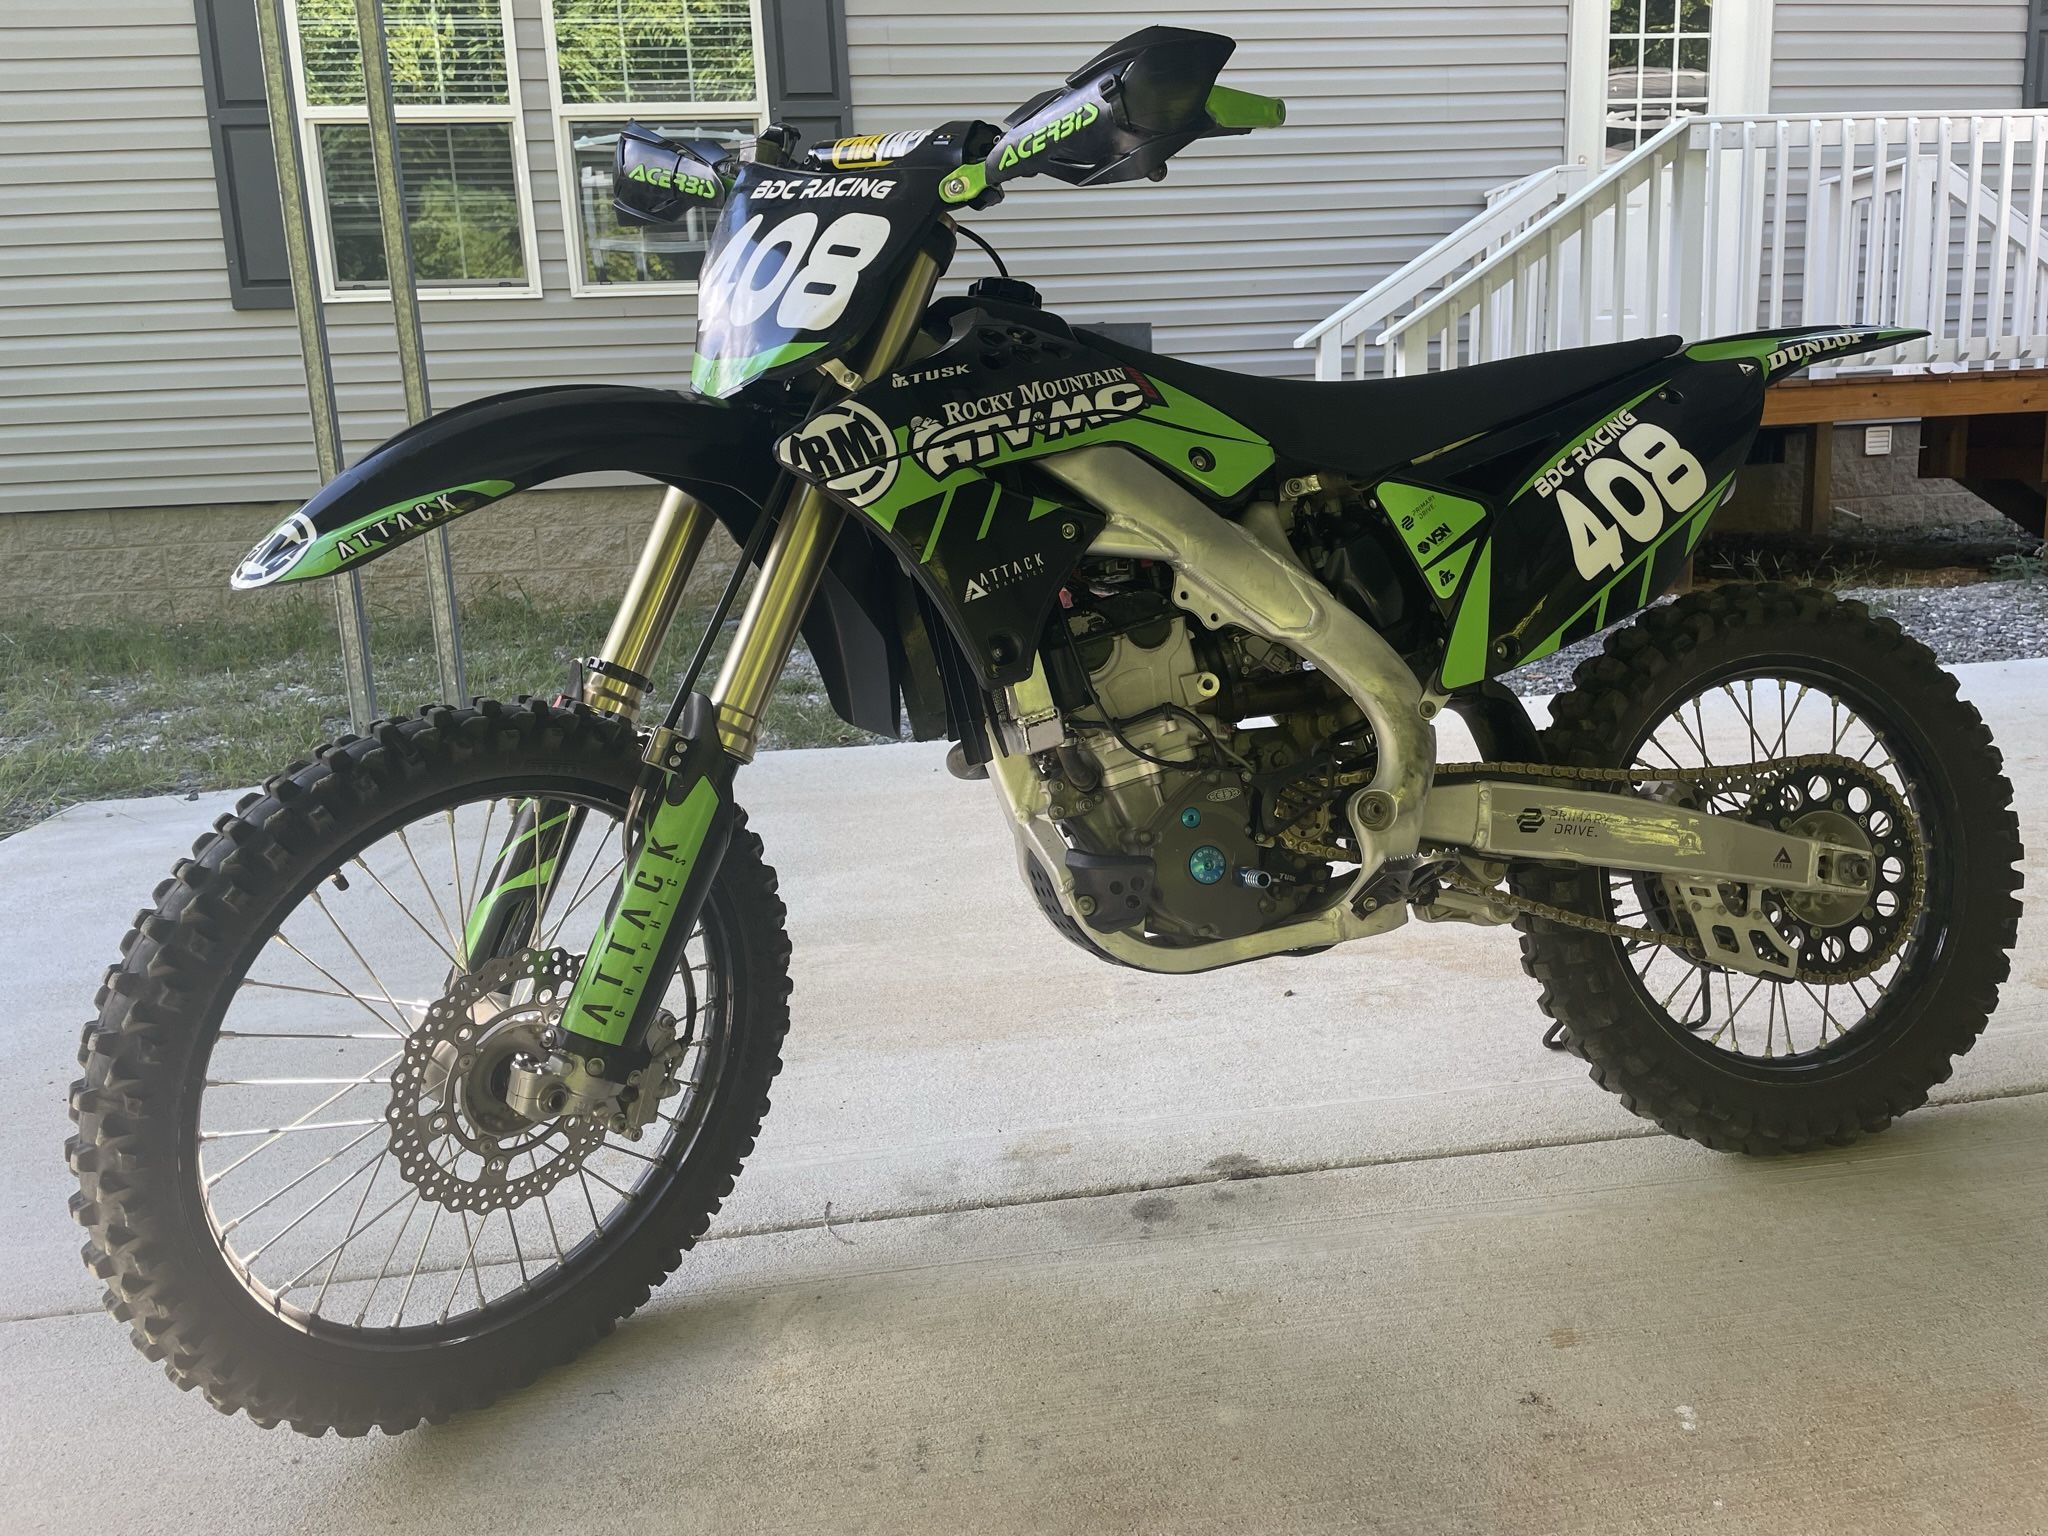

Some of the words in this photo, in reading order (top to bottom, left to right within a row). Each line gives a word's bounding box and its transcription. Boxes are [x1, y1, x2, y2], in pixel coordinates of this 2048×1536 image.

[998, 102, 1099, 171] ACERBIS
[628, 164, 716, 199] ACERBIS
[750, 179, 803, 200] BDC
[799, 177, 898, 200] RACING
[698, 212, 891, 332] 408
[908, 363, 971, 385] TUSK
[941, 393, 1014, 426] ROCKY
[1017, 367, 1127, 405] MOUNTAIN
[1533, 456, 1575, 498] BDC
[1571, 408, 1639, 467] RACING
[336, 493, 457, 560] ATTACK
[1555, 422, 1708, 581] 408
[979, 552, 1045, 587] ATTACK
[581, 836, 680, 1026] ATTACK
[613, 857, 687, 1018] GRAPHICS
